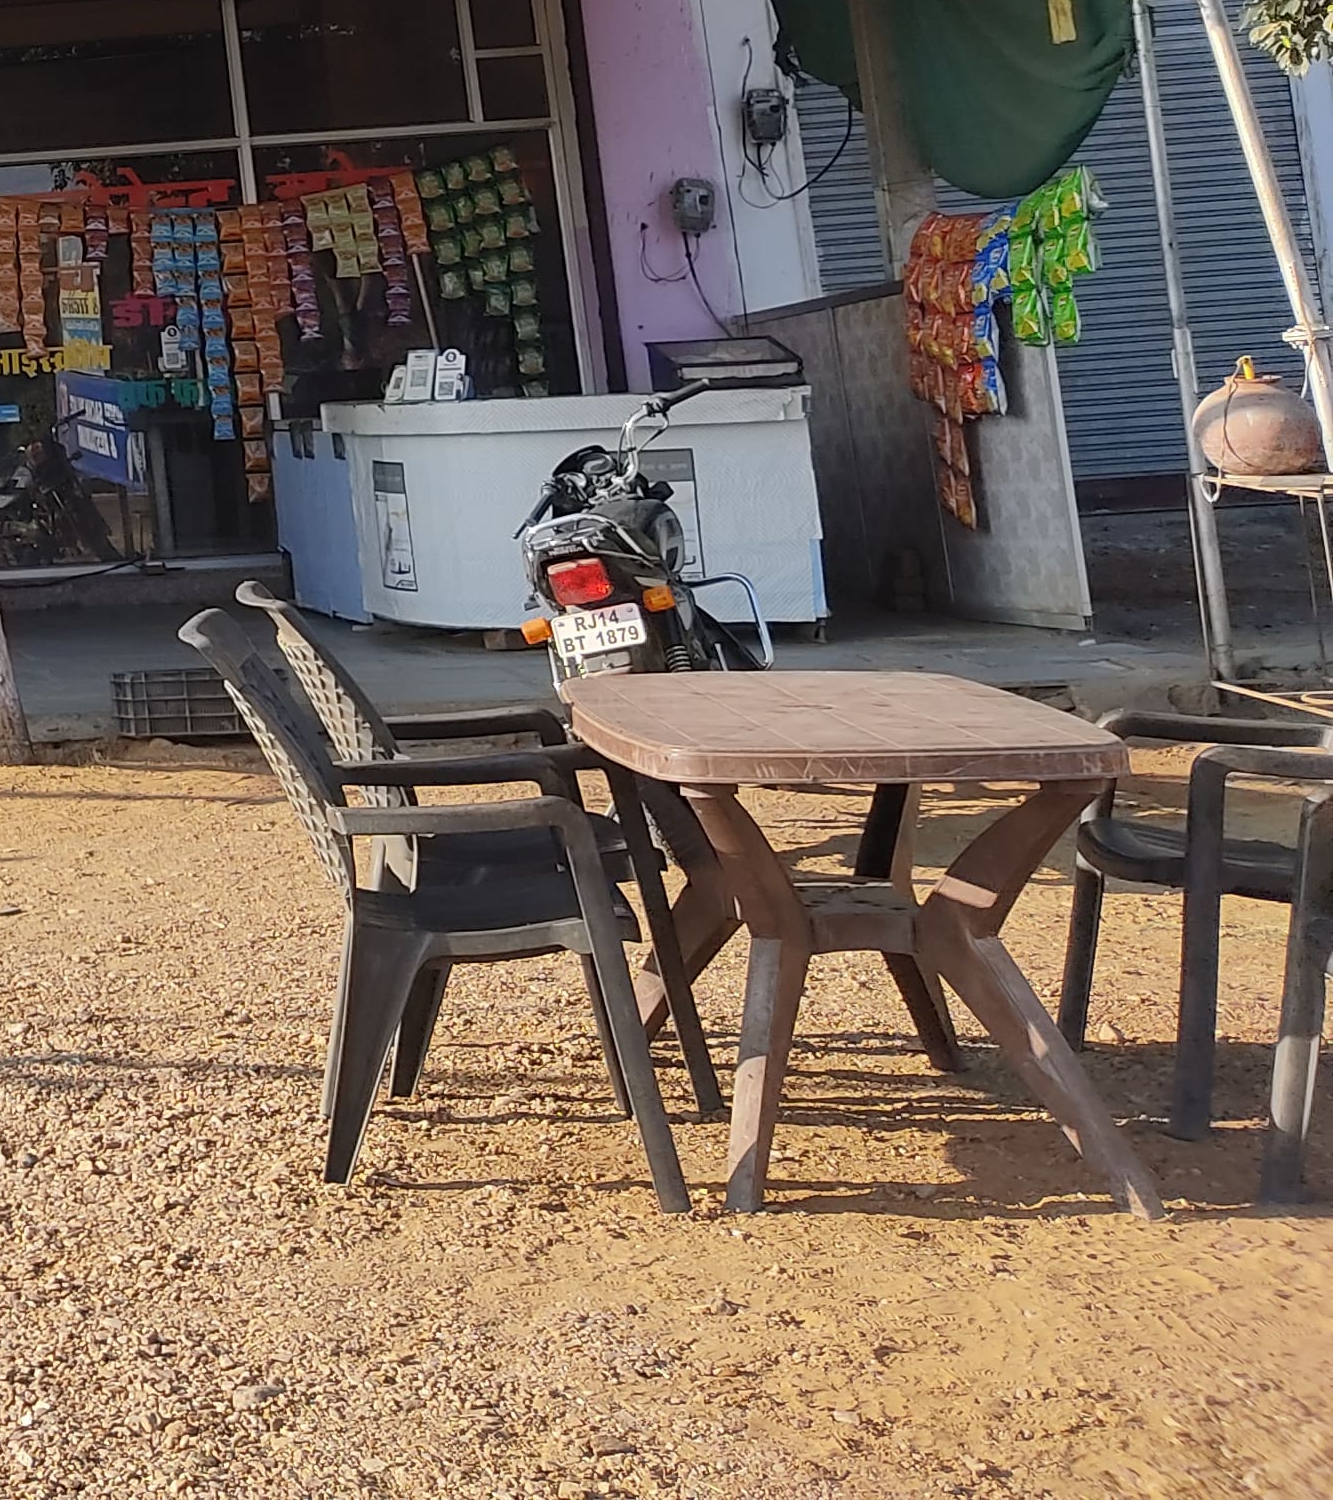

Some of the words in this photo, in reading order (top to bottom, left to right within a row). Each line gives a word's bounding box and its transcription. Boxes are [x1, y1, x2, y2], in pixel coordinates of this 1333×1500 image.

[574, 610, 620, 632] RJ14
[562, 634, 586, 654] BT
[596, 625, 640, 648] 1879
